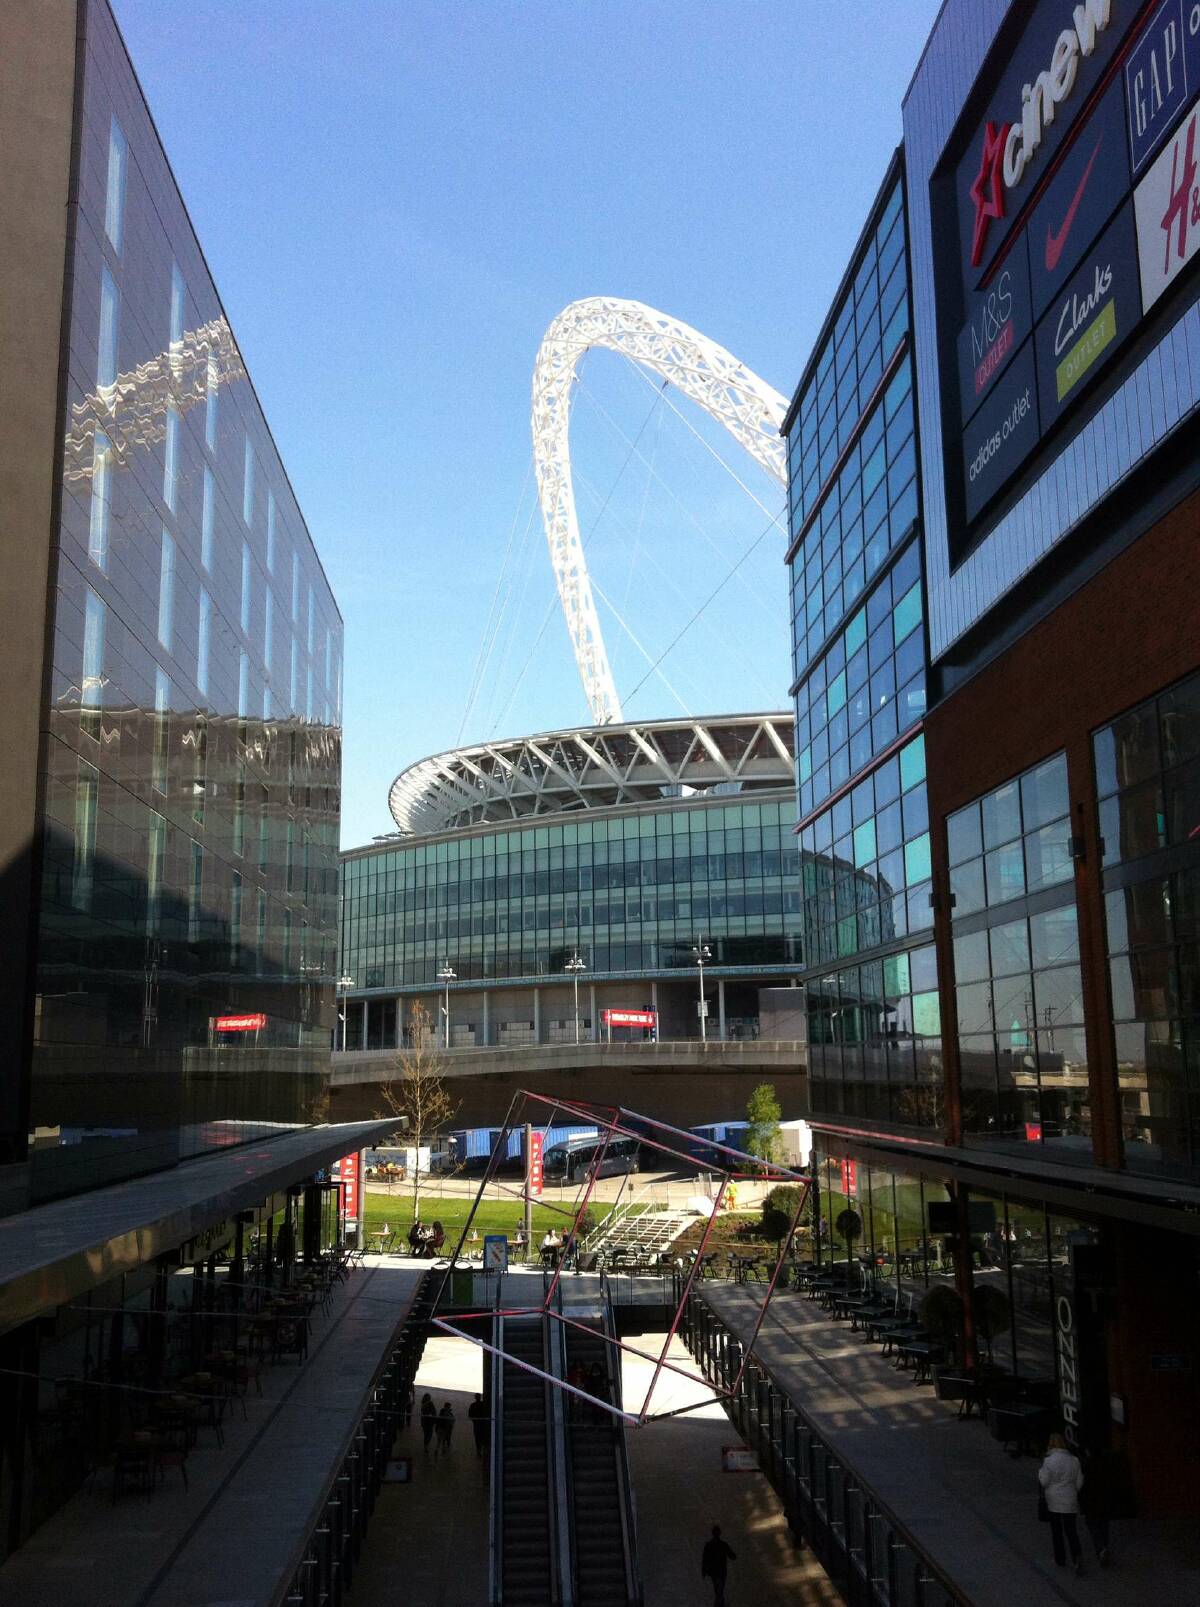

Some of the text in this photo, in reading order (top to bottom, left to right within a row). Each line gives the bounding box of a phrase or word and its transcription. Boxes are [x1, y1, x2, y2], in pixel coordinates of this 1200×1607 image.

[1134, 20, 1177, 137] GAP
[971, 271, 1012, 368] M&S
[979, 327, 1009, 385] OUTLET
[1055, 264, 1112, 356] Clarks
[1066, 321, 1105, 378] OUTLET
[969, 387, 1031, 481] adidas outlet
[1057, 1296, 1080, 1448] PREZZO
